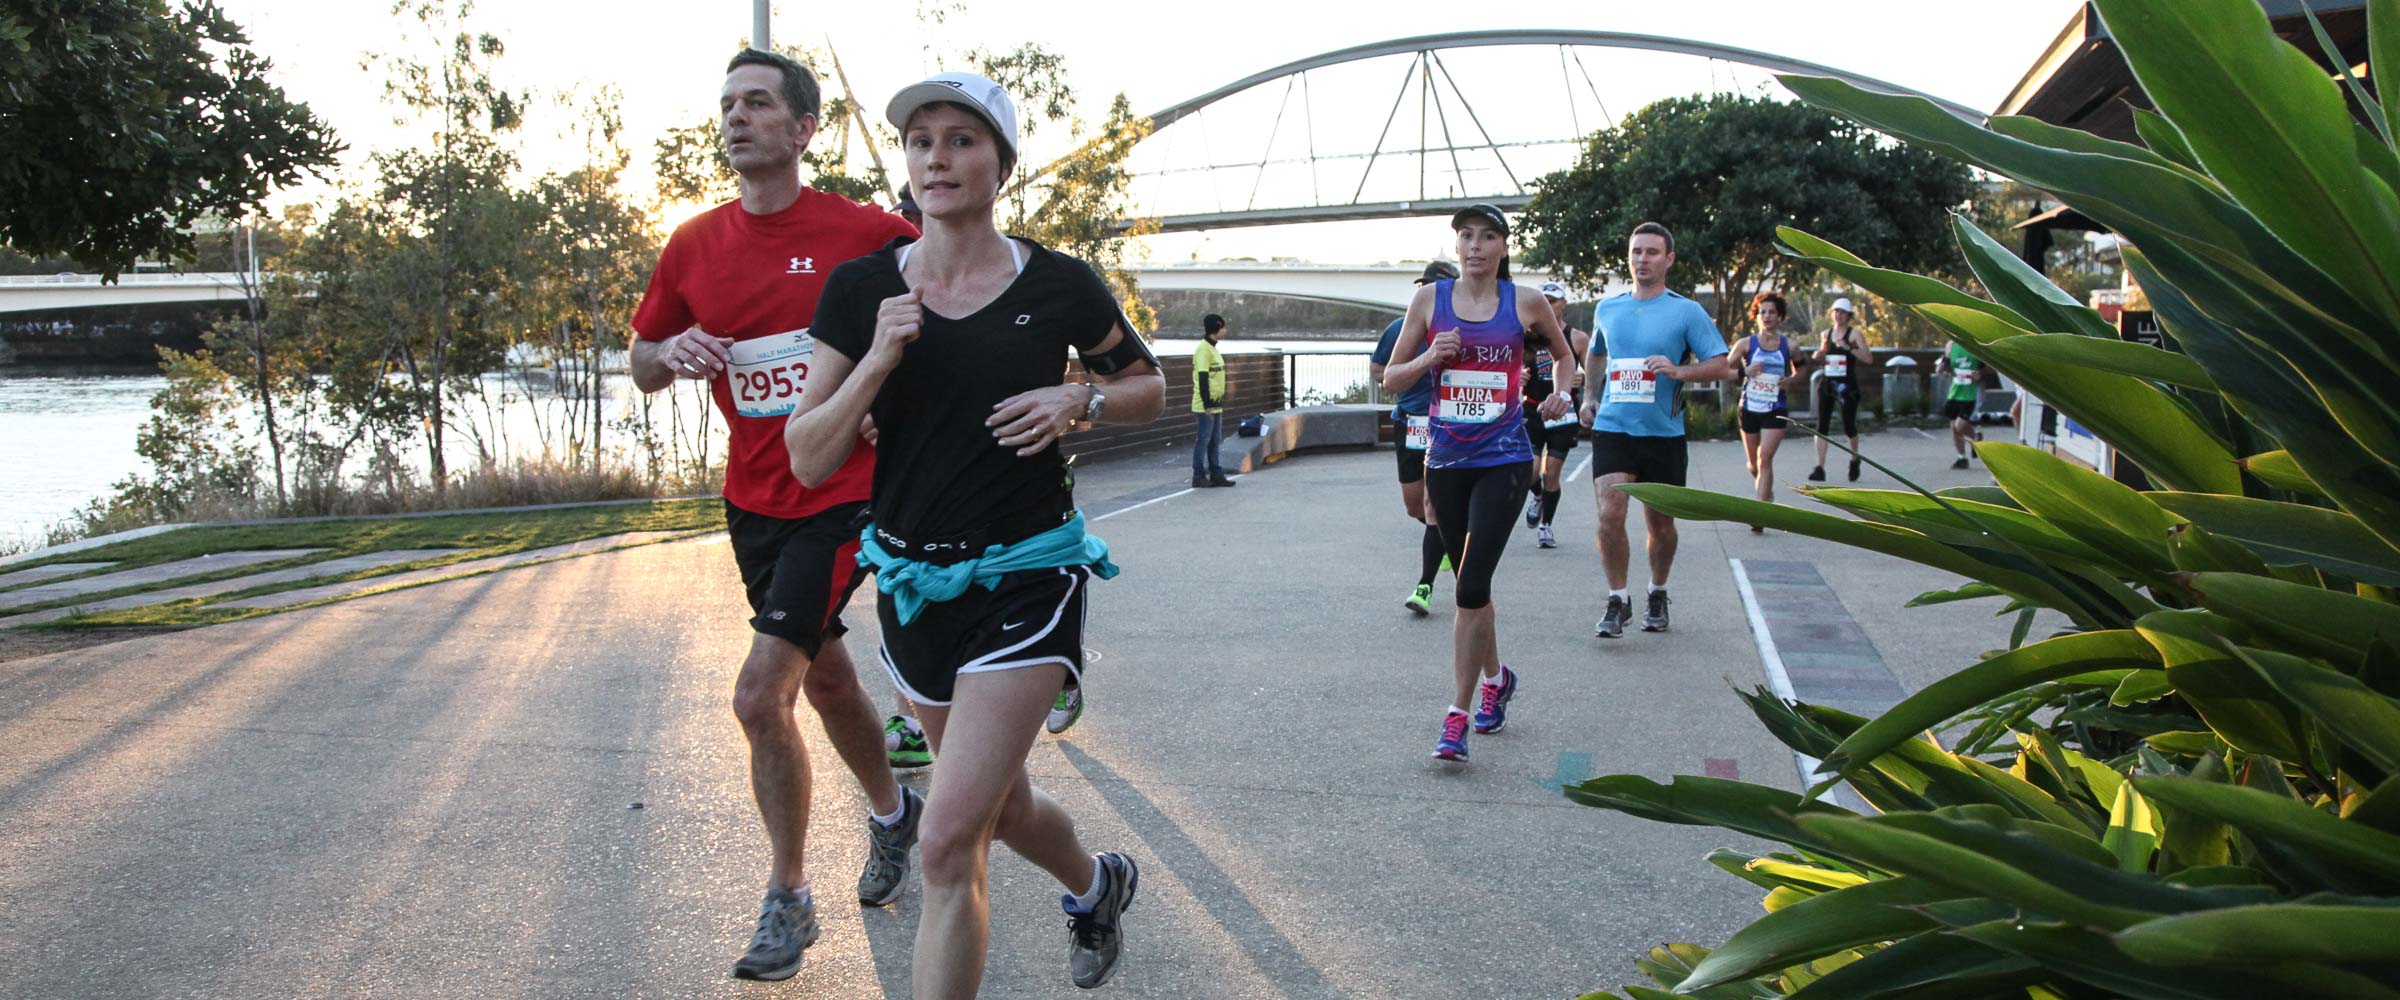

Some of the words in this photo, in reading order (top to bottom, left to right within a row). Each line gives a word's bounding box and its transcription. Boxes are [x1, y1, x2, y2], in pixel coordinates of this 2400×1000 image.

[1474, 344, 1513, 363] RUN
[1620, 370, 1644, 381] DAVO
[734, 362, 809, 402] 2953
[1621, 381, 1640, 391] 1891
[1752, 380, 1776, 392] 2952
[1450, 387, 1494, 402] LAURA
[1455, 402, 1486, 416] 1785
[1409, 426, 1414, 436] J
[1415, 427, 1428, 437] COS
[1419, 436, 1427, 446] 13
